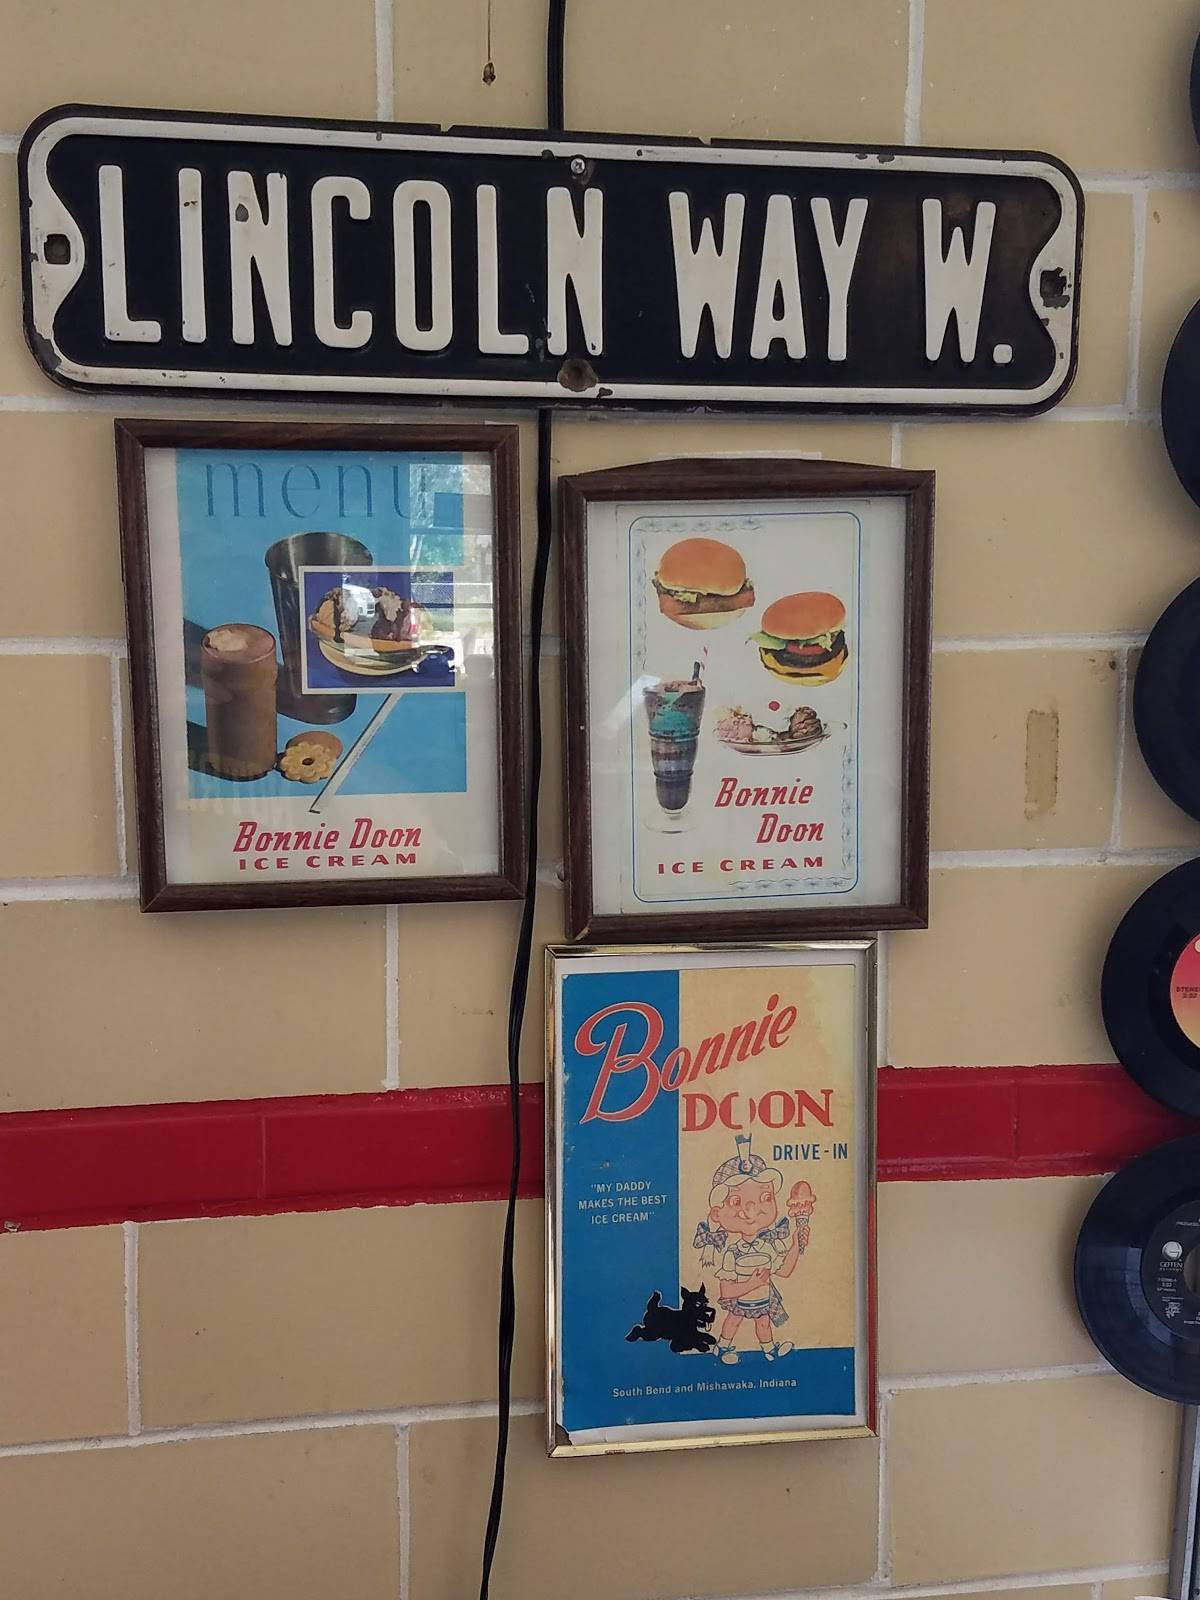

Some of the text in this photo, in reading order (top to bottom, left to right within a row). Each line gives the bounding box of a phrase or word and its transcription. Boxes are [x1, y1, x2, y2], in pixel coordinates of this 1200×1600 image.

[99, 165, 1013, 364] LINCOLN WAY W.
[714, 777, 814, 808] Bonnie
[233, 817, 422, 852] Bonnie Doon
[756, 813, 824, 844] Doon
[239, 853, 416, 870] ICE CREAM
[658, 856, 823, 875] ICE CREAM
[575, 993, 797, 1124] Bonnie
[773, 1143, 848, 1160] DRIVE-IN
[616, 1181, 651, 1192] DADDY
[578, 1194, 667, 1210] MAKES THE BEST
[591, 1214, 608, 1225] ICE
[612, 1377, 797, 1398] South Bend and Mishawaka, Indiana
